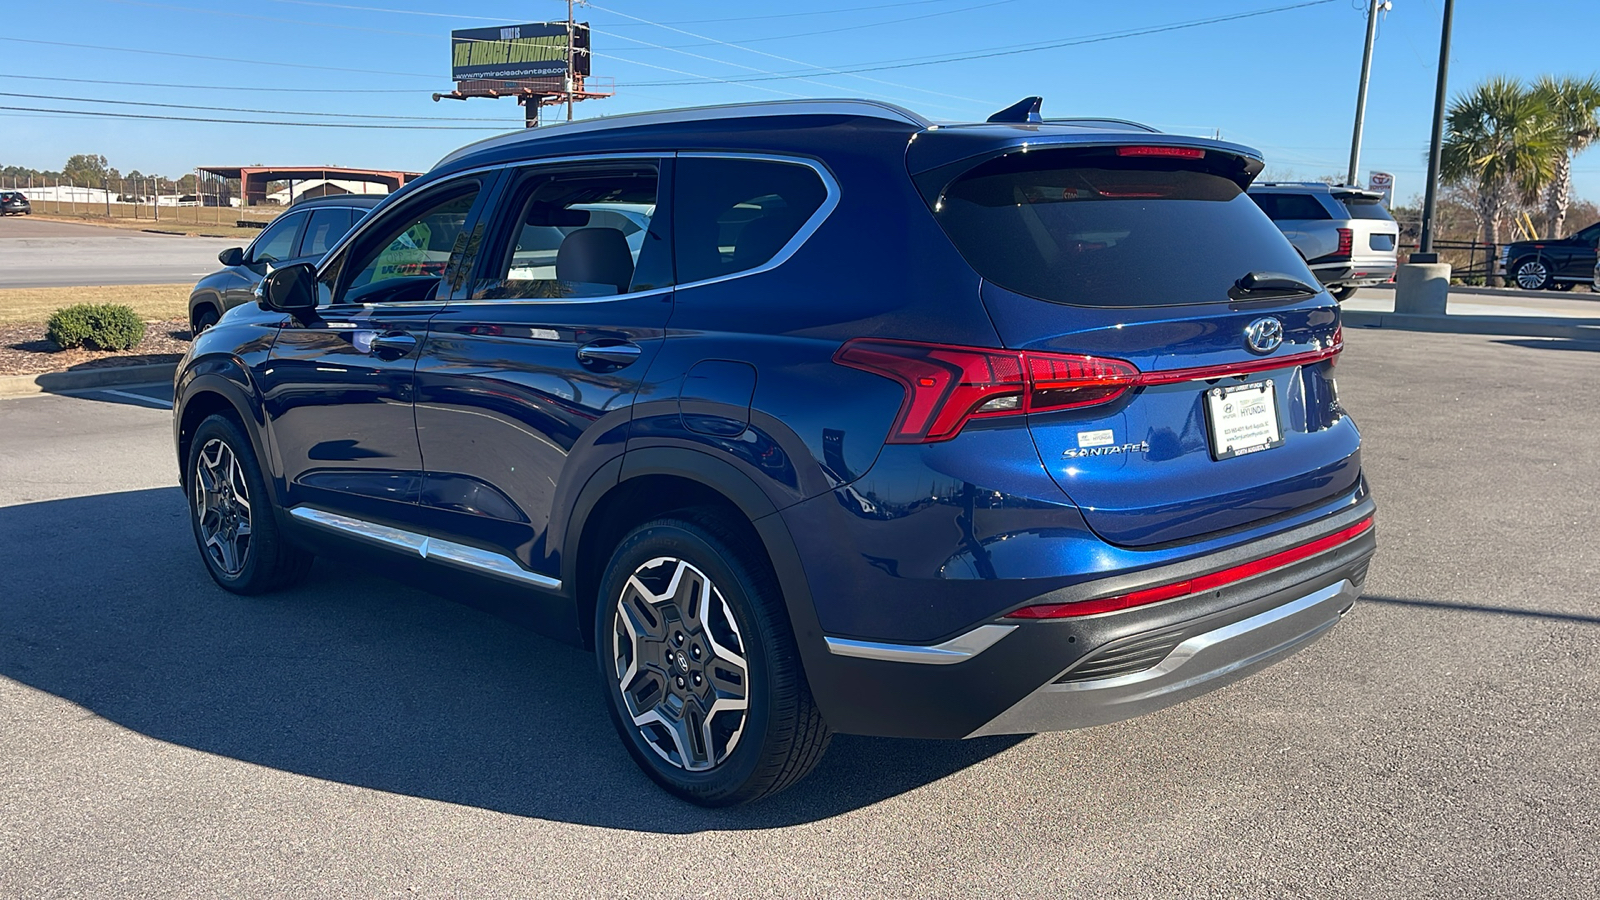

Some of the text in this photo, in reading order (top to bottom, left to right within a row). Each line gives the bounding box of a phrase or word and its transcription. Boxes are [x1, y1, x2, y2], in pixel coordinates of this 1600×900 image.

[515, 27, 520, 39] IS
[454, 42, 471, 67] THE
[469, 40, 509, 66] MIRACLE
[1240, 405, 1266, 417] HYUNDAI
